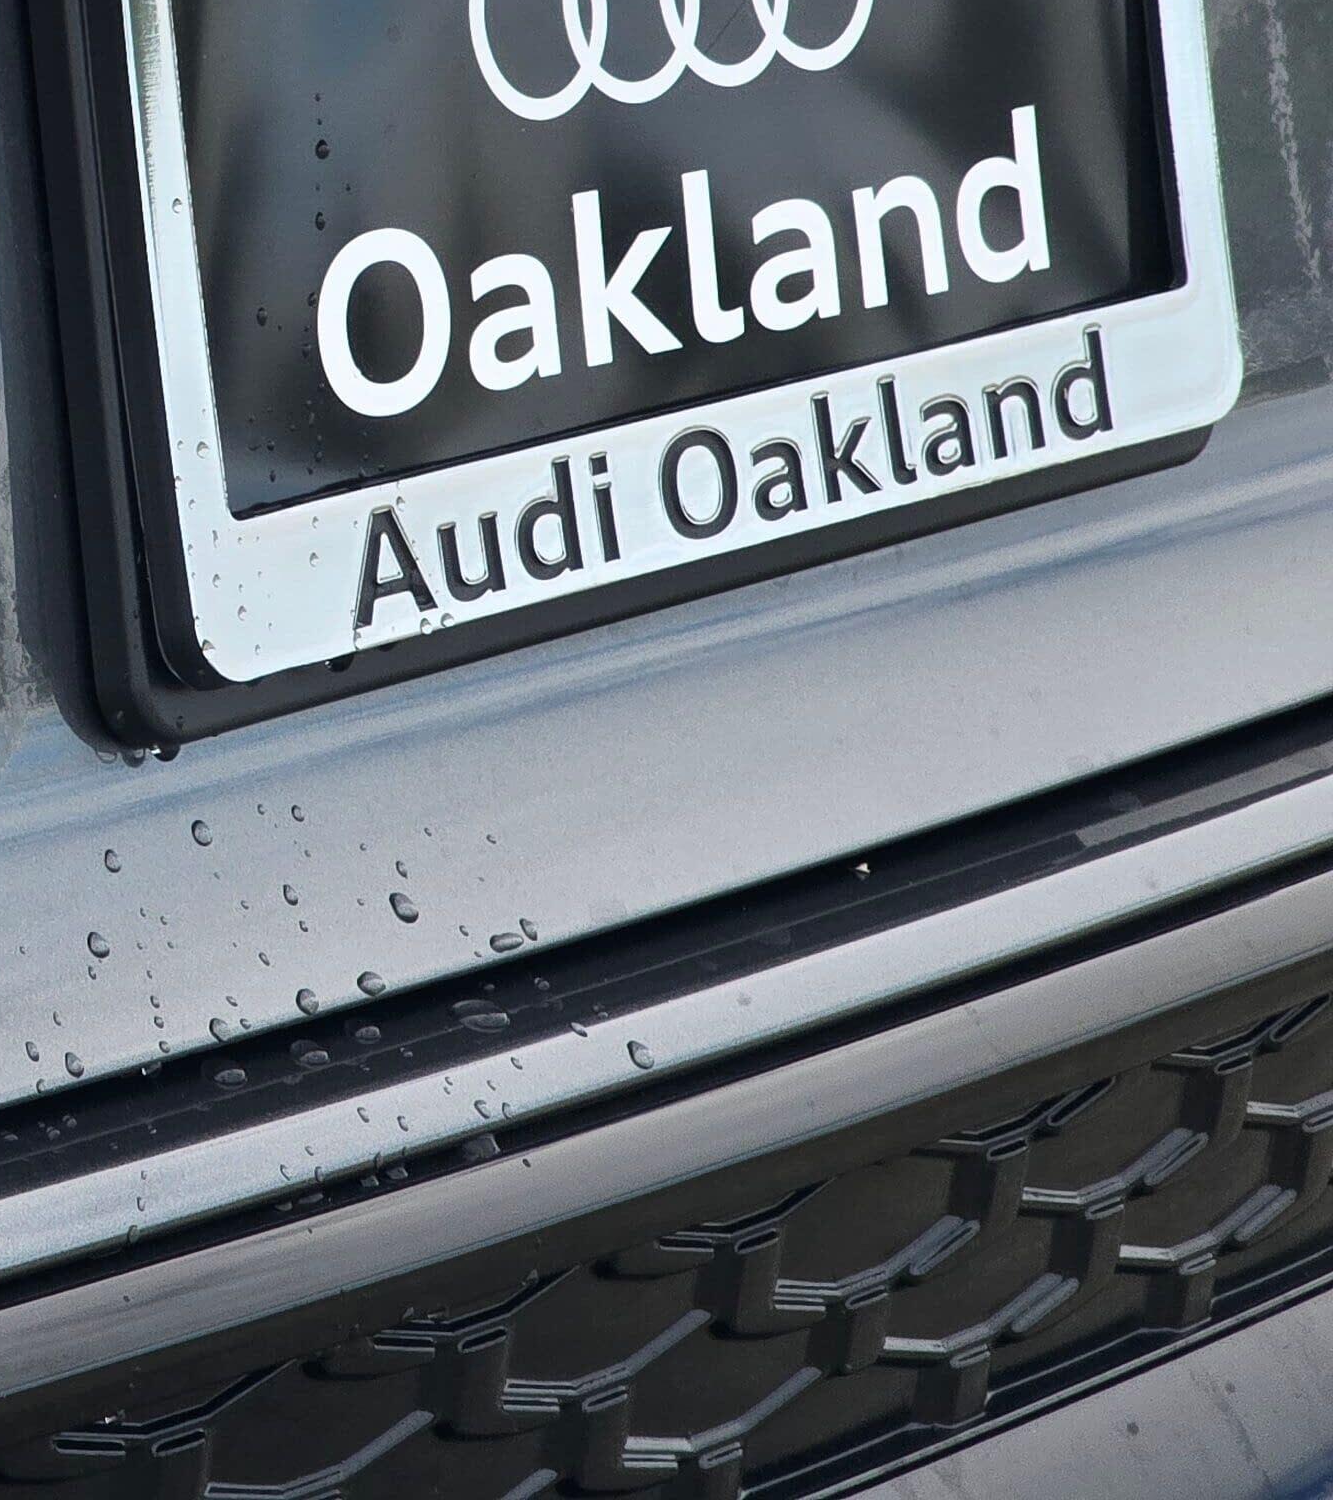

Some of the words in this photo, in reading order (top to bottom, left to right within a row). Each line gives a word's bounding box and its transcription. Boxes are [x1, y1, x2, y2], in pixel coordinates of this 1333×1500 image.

[317, 105, 1050, 417] Oakland
[355, 455, 623, 629] Audi
[660, 327, 1115, 541] Oakland
